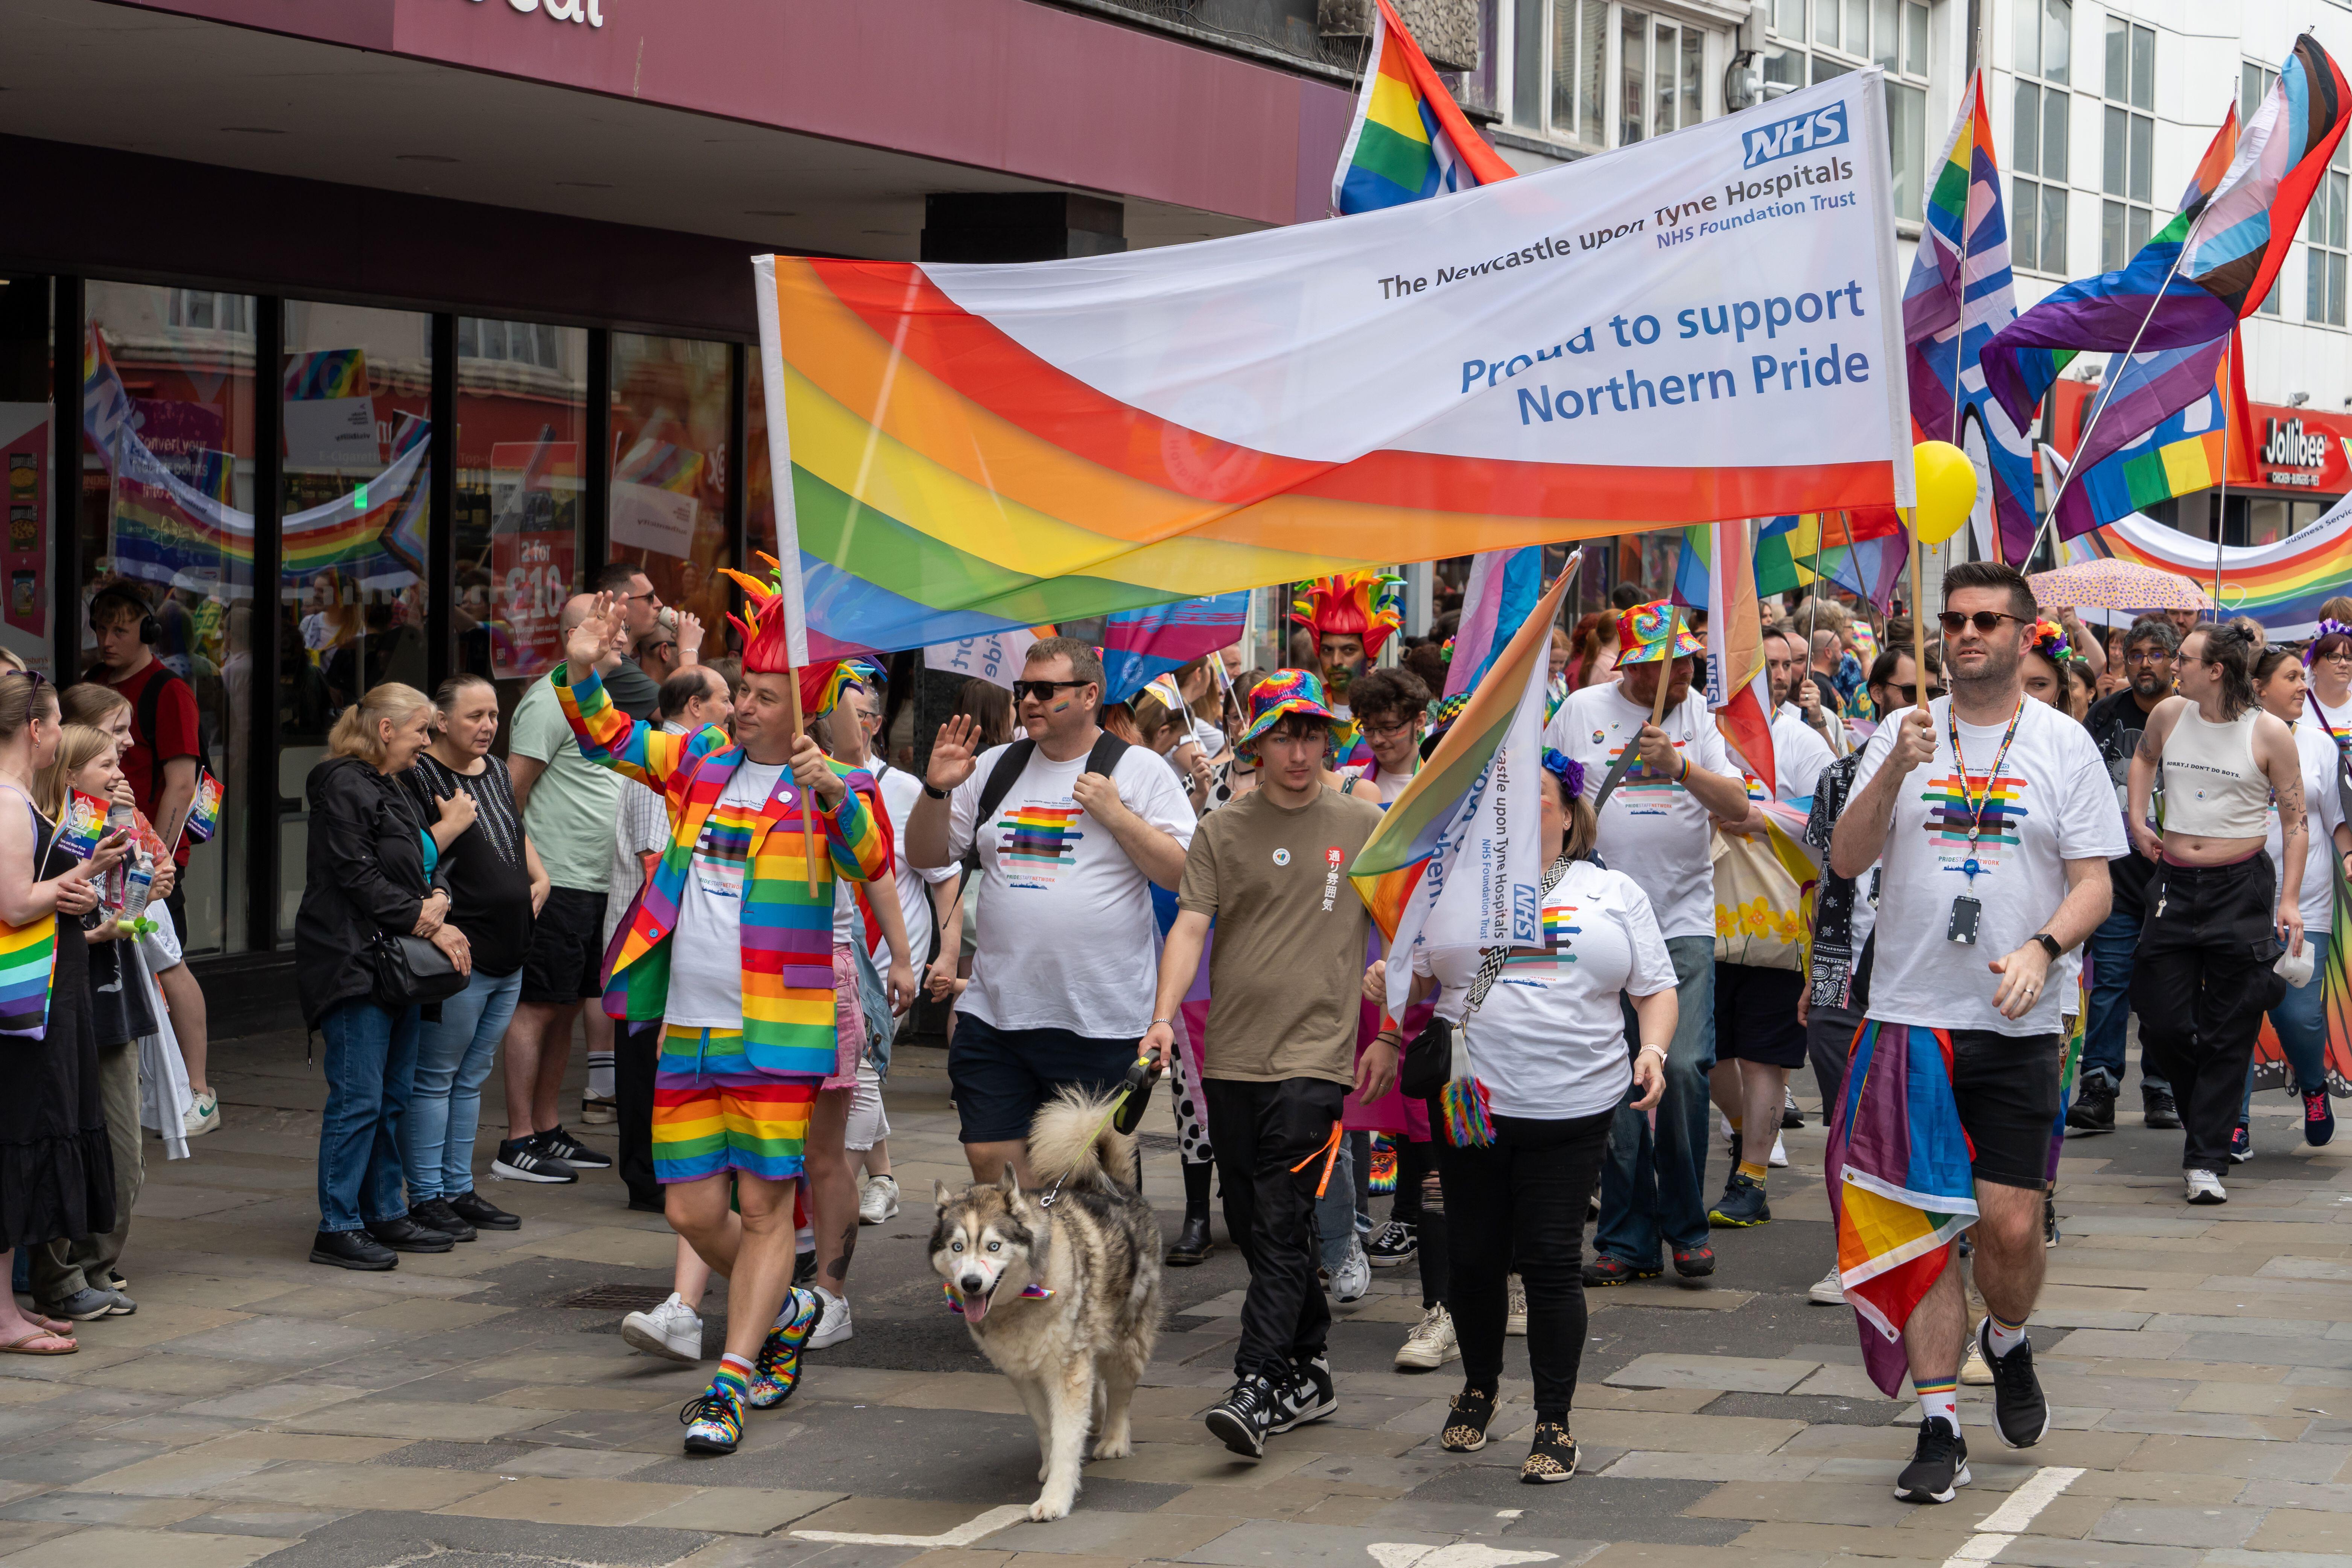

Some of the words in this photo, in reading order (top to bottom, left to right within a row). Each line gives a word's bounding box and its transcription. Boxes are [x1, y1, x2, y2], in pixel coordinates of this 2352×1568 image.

[1744, 101, 1848, 169] NHS
[1378, 275, 1427, 300] The
[1436, 235, 1572, 287] Newcastle
[1579, 217, 1645, 250] upon
[1654, 192, 1718, 229] Tyne
[1726, 157, 1853, 207] Hospitals
[1657, 225, 1694, 249] NHS
[1699, 200, 1806, 238] Foundation
[1811, 190, 1856, 212] Trust
[1608, 315, 1661, 347] to
[1677, 279, 1865, 343] support
[1517, 369, 1736, 425] Northern
[1752, 343, 1870, 395] Pride
[2267, 417, 2325, 467] Jollibee
[2272, 472, 2290, 484] CHICKEN
[522, 541, 531, 563] 2
[534, 539, 551, 562] for
[506, 564, 563, 619] £10
[2013, 711, 2021, 723] NHS
[1997, 748, 2006, 762] NHS
[1959, 773, 1968, 786] NHS
[1988, 772, 1996, 785] NHS
[2222, 770, 2241, 779] BOYS.
[1493, 797, 1506, 835] upon
[72, 848, 84, 856] Service
[1482, 839, 1491, 859] NHS
[1493, 837, 1509, 873] Tyne
[700, 877, 743, 890] RIDESTAFFNETWOR
[1007, 874, 1056, 883] PRIDESTAFFNETWORK
[1321, 849, 1340, 912] 通り雰囲気
[1481, 862, 1491, 916] Foundation
[1494, 873, 1509, 939] Hospitals
[1514, 884, 1535, 941] NHS
[1480, 917, 1490, 939] Trust
[1322, 1170, 1330, 1184] NUTH
